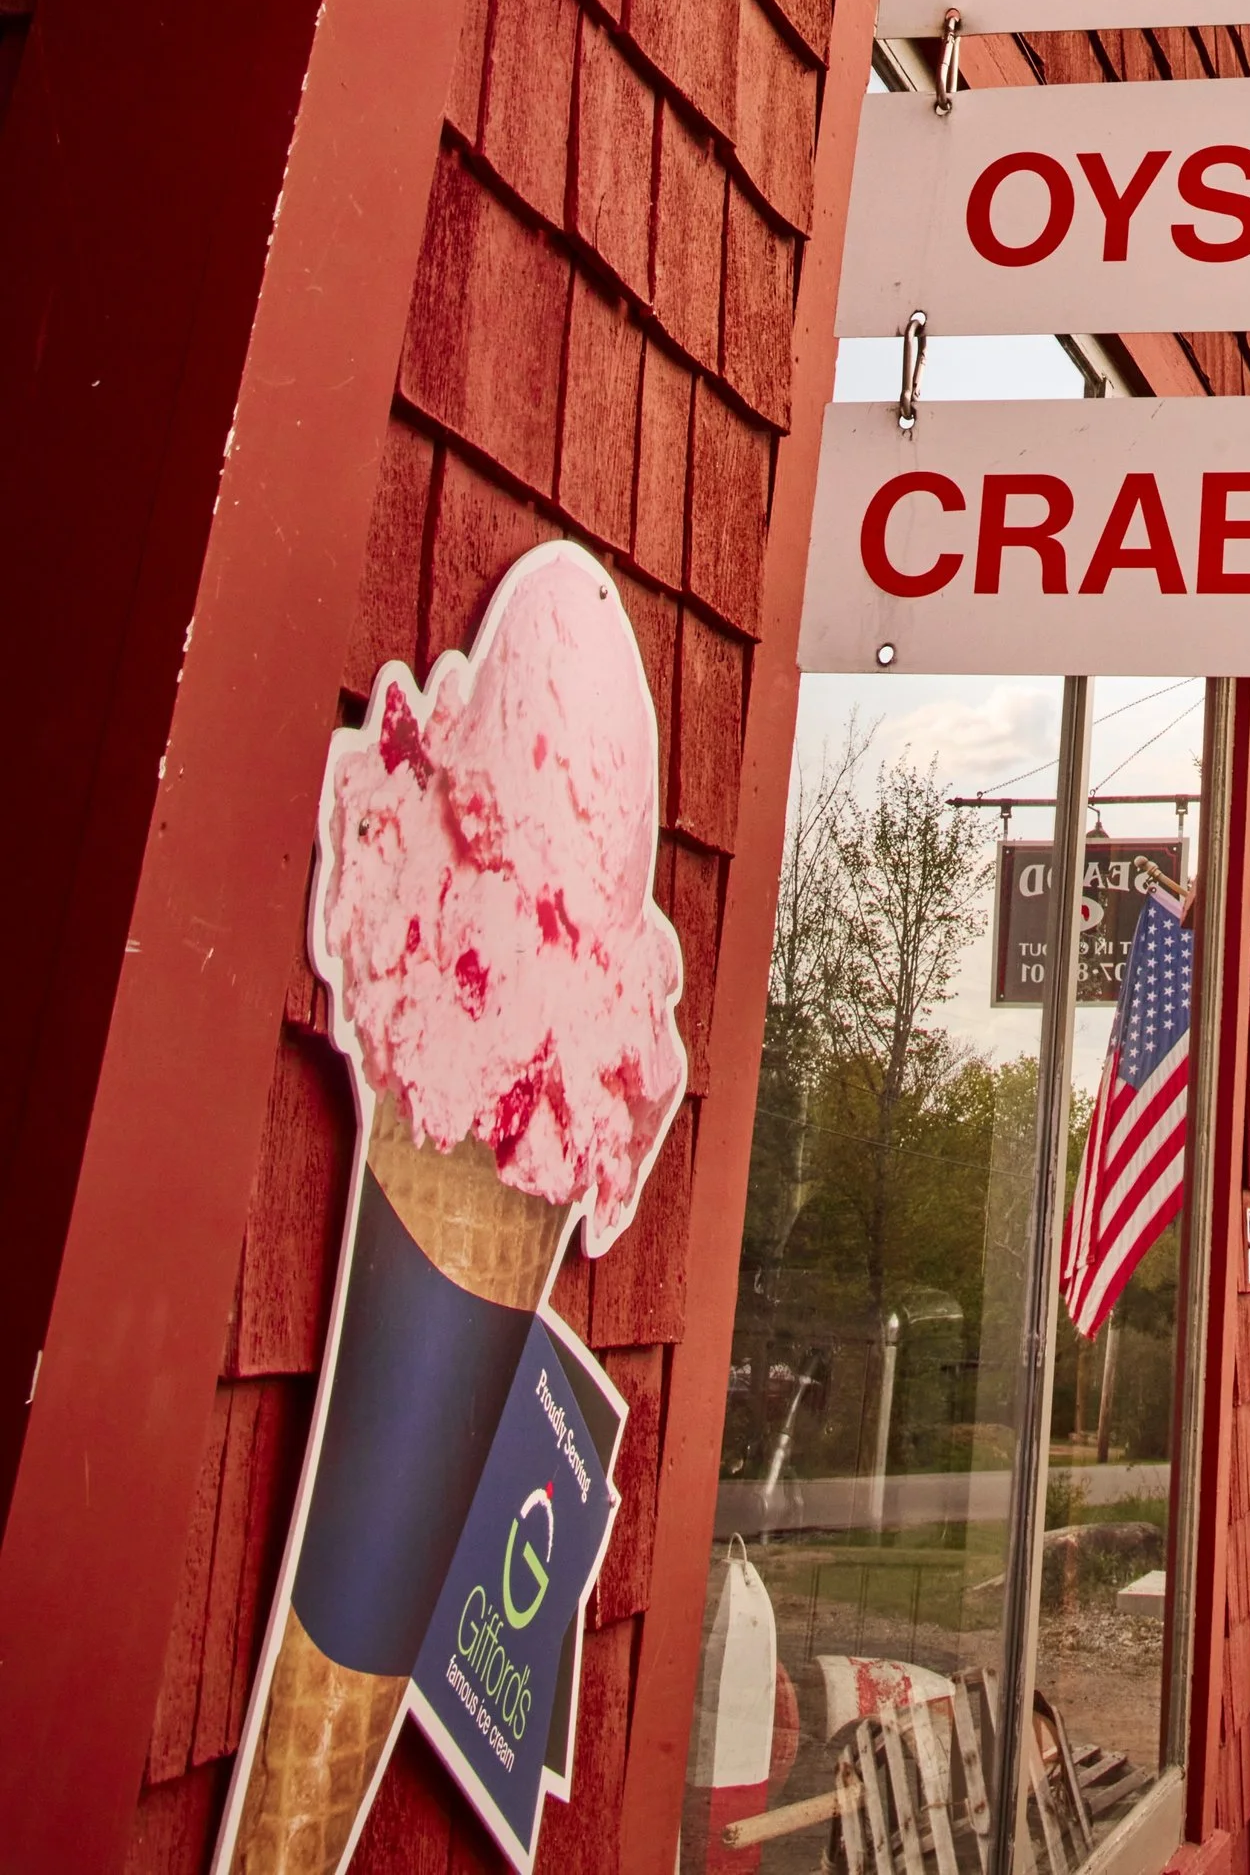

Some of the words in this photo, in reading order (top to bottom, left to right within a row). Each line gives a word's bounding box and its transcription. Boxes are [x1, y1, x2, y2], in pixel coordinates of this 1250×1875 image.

[535, 1368, 567, 1449] Proudly
[564, 1429, 591, 1503] Serving
[446, 1654, 477, 1716] famous
[476, 1699, 490, 1734] ice
[489, 1726, 515, 1773] cream
[457, 1585, 531, 1740] Gifford's
